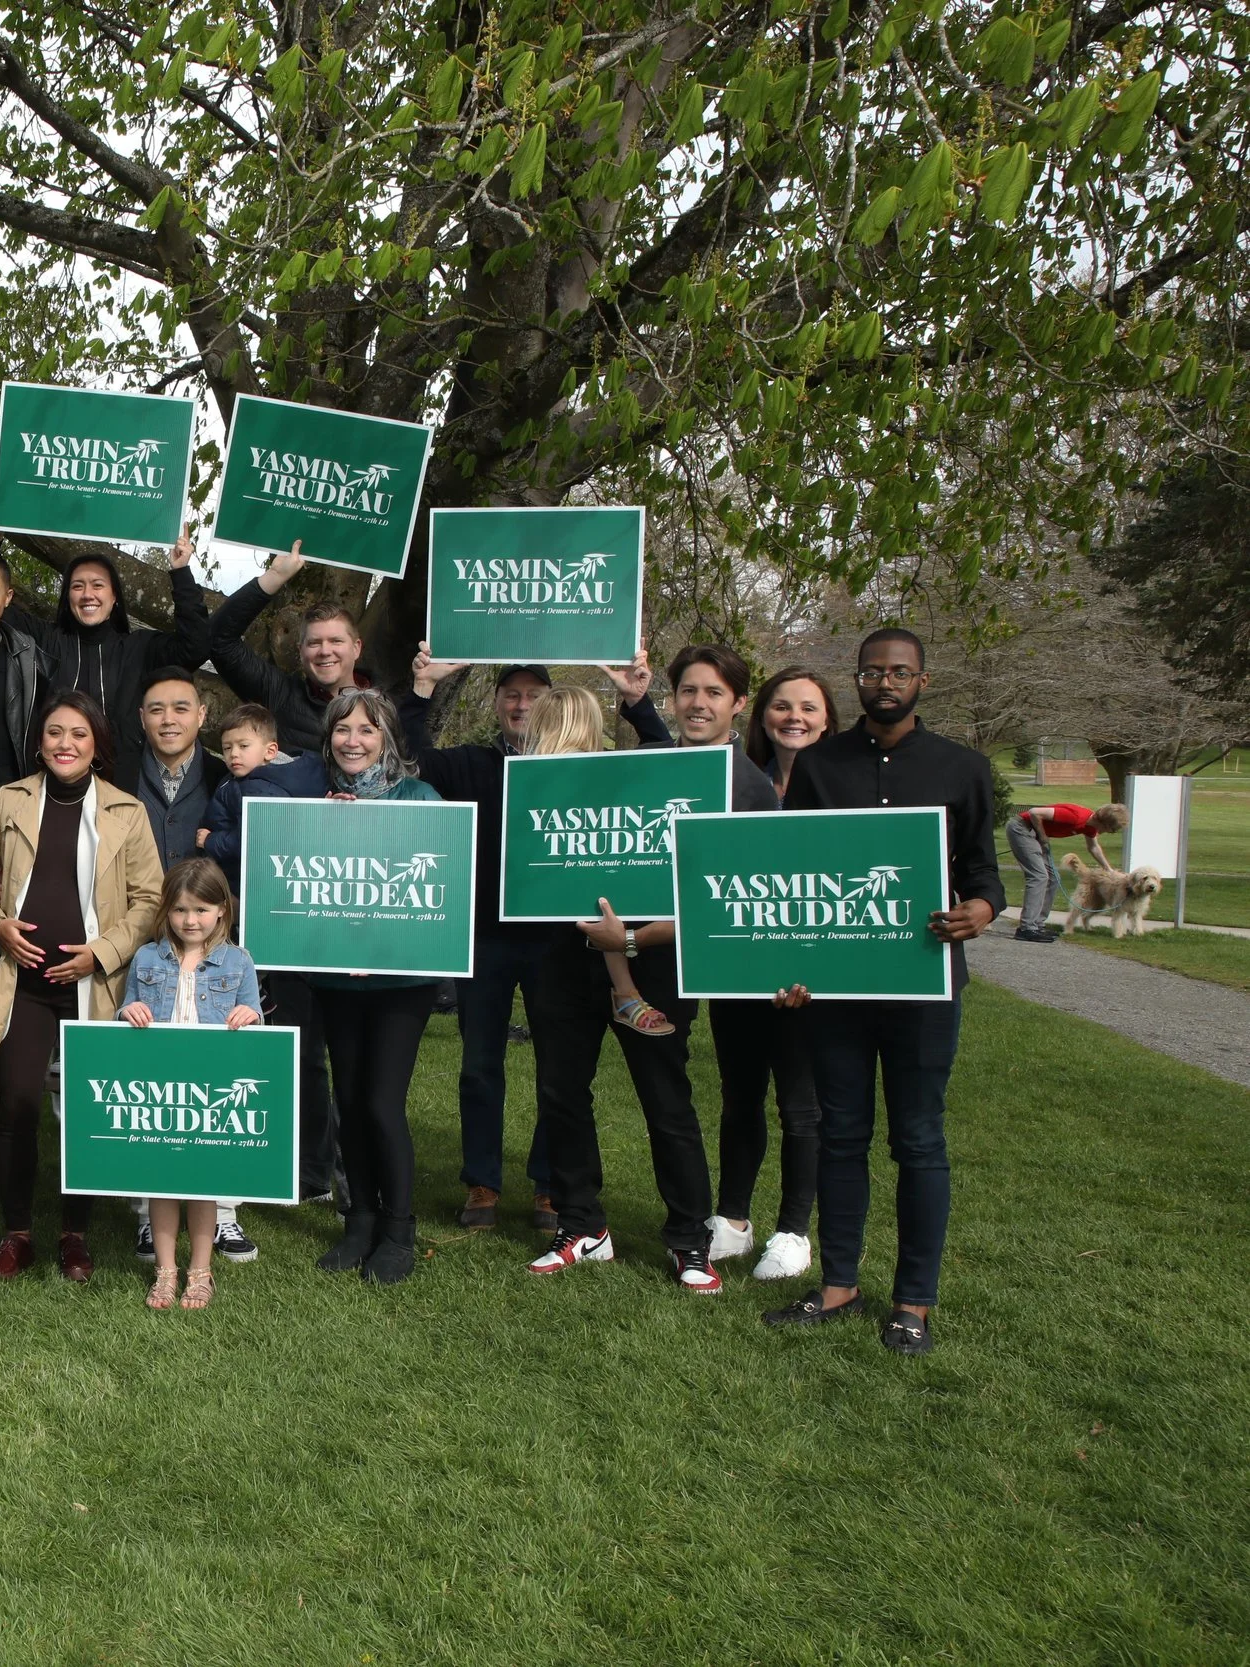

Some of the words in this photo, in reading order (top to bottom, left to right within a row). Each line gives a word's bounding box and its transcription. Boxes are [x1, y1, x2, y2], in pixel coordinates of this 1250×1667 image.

[20, 433, 120, 461] YASMIN
[32, 456, 165, 489] TRUDEAU
[250, 447, 351, 484] YASMIN
[59, 483, 76, 491] State
[75, 485, 97, 493] Senate
[102, 487, 133, 496] Democrat
[260, 471, 394, 515] TRUDEAU
[284, 501, 301, 510] State
[301, 504, 323, 514] Senate
[327, 509, 359, 521] Democrat
[453, 559, 563, 580] YASMIN
[468, 581, 614, 604] TRUDEAU
[487, 607, 499, 615] for
[529, 806, 644, 831] YASMIN
[544, 829, 673, 856] TRUDEA
[270, 855, 390, 881] YASMIN
[564, 860, 577, 869] for
[287, 880, 446, 909] TRUDEAU
[704, 873, 843, 899] YASMIN
[308, 909, 320, 918] for
[373, 912, 409, 920] Democrat
[416, 913, 432, 921] 27th
[725, 900, 911, 927] TRUDEAU
[752, 932, 766, 941] for
[790, 932, 820, 940] Senate
[828, 932, 870, 940] Democrat
[878, 932, 897, 941] 27th
[88, 1080, 210, 1106] YASMIN
[106, 1105, 268, 1135] TRUDEAU
[128, 1135, 141, 1143] for
[162, 1136, 188, 1144] Senate
[194, 1138, 231, 1146] Democrat
[238, 1140, 255, 1148] 27th
